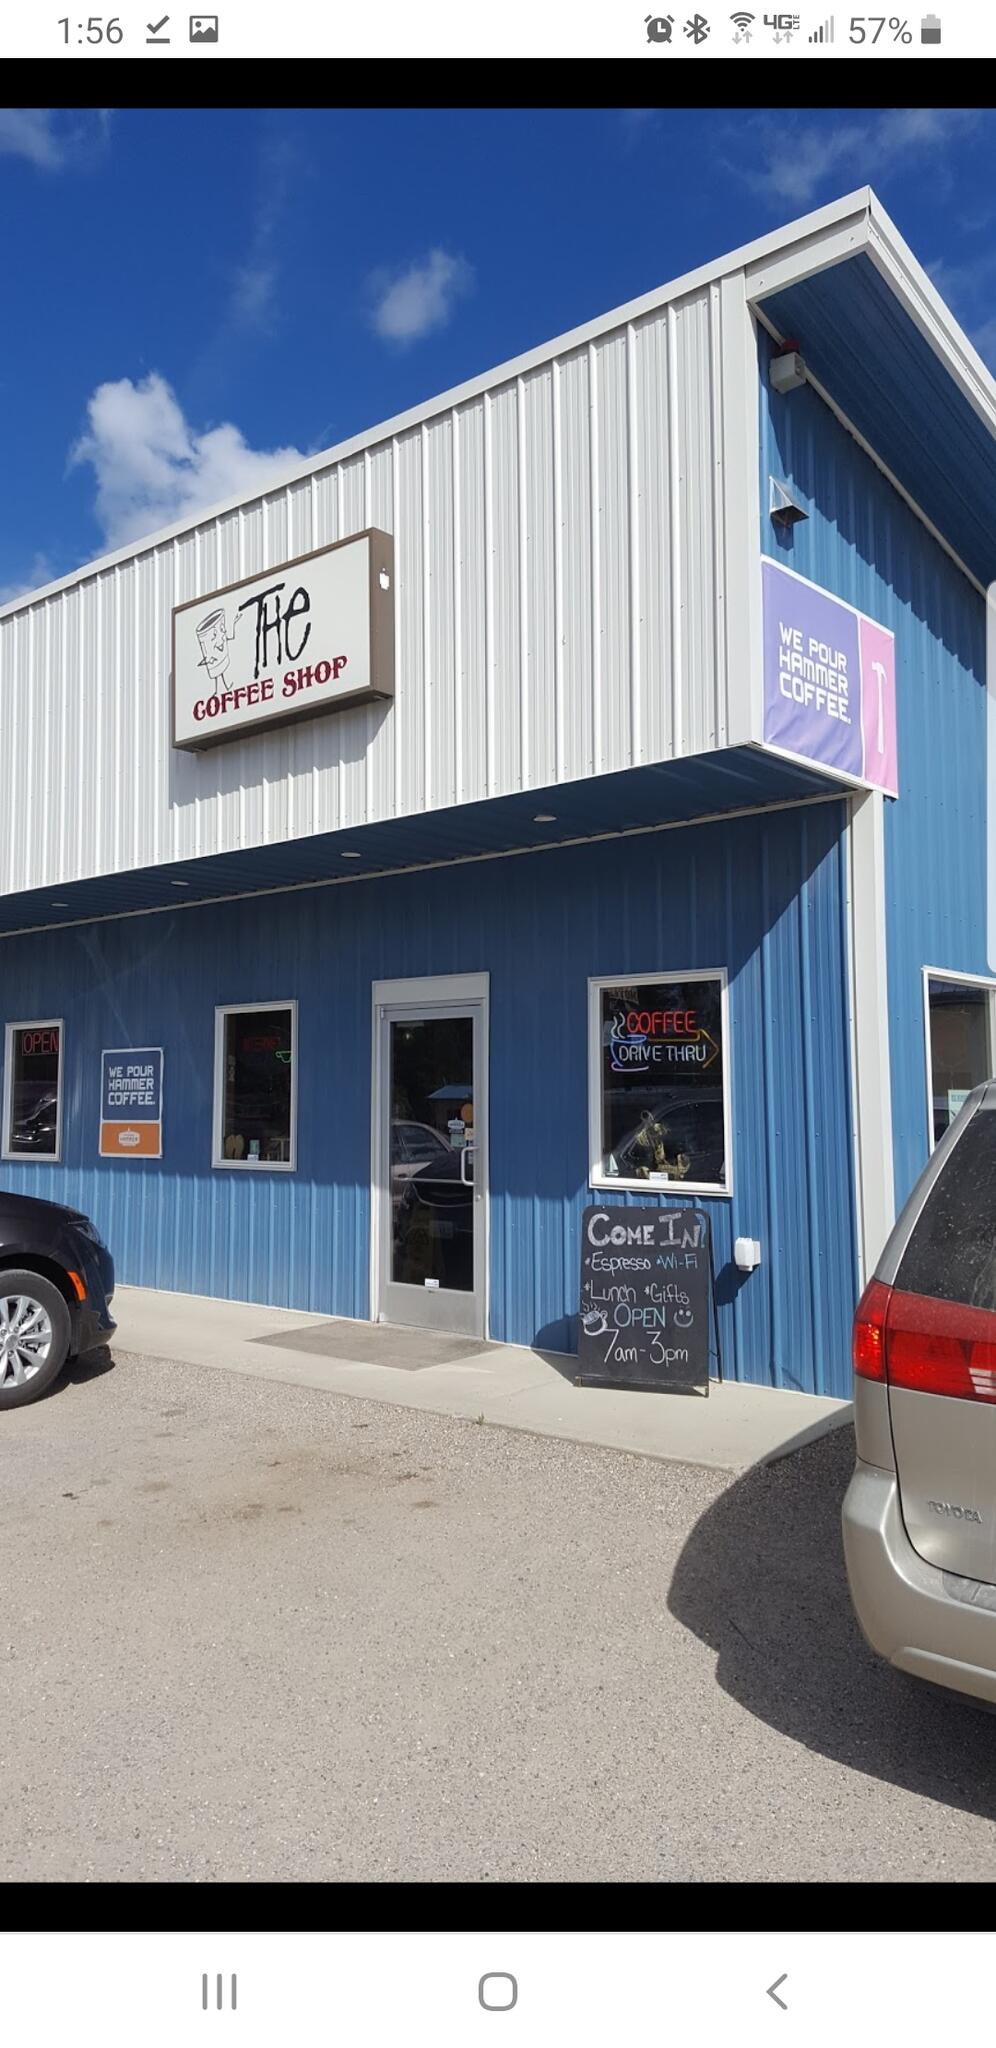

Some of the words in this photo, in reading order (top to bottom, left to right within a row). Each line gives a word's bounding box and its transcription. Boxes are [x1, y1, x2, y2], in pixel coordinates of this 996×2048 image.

[779, 621, 803, 652] WE
[809, 637, 847, 674] POUR
[779, 646, 848, 697] HAMMER
[193, 678, 274, 721] COFFEE
[282, 655, 348, 698] SHOP
[779, 672, 851, 725] COFFEE.
[626, 1011, 698, 1034] COFFEE
[23, 1031, 59, 1053] OPEN
[618, 1045, 662, 1062] DRIVE
[667, 1045, 706, 1062] THRU
[108, 1067, 123, 1078] WE
[127, 1065, 154, 1077] POUR
[108, 1078, 154, 1091] HAMMER
[587, 1213, 655, 1247] COME
[613, 1302, 666, 1328] OPEN
[927, 1500, 983, 1524] TOYOTA
